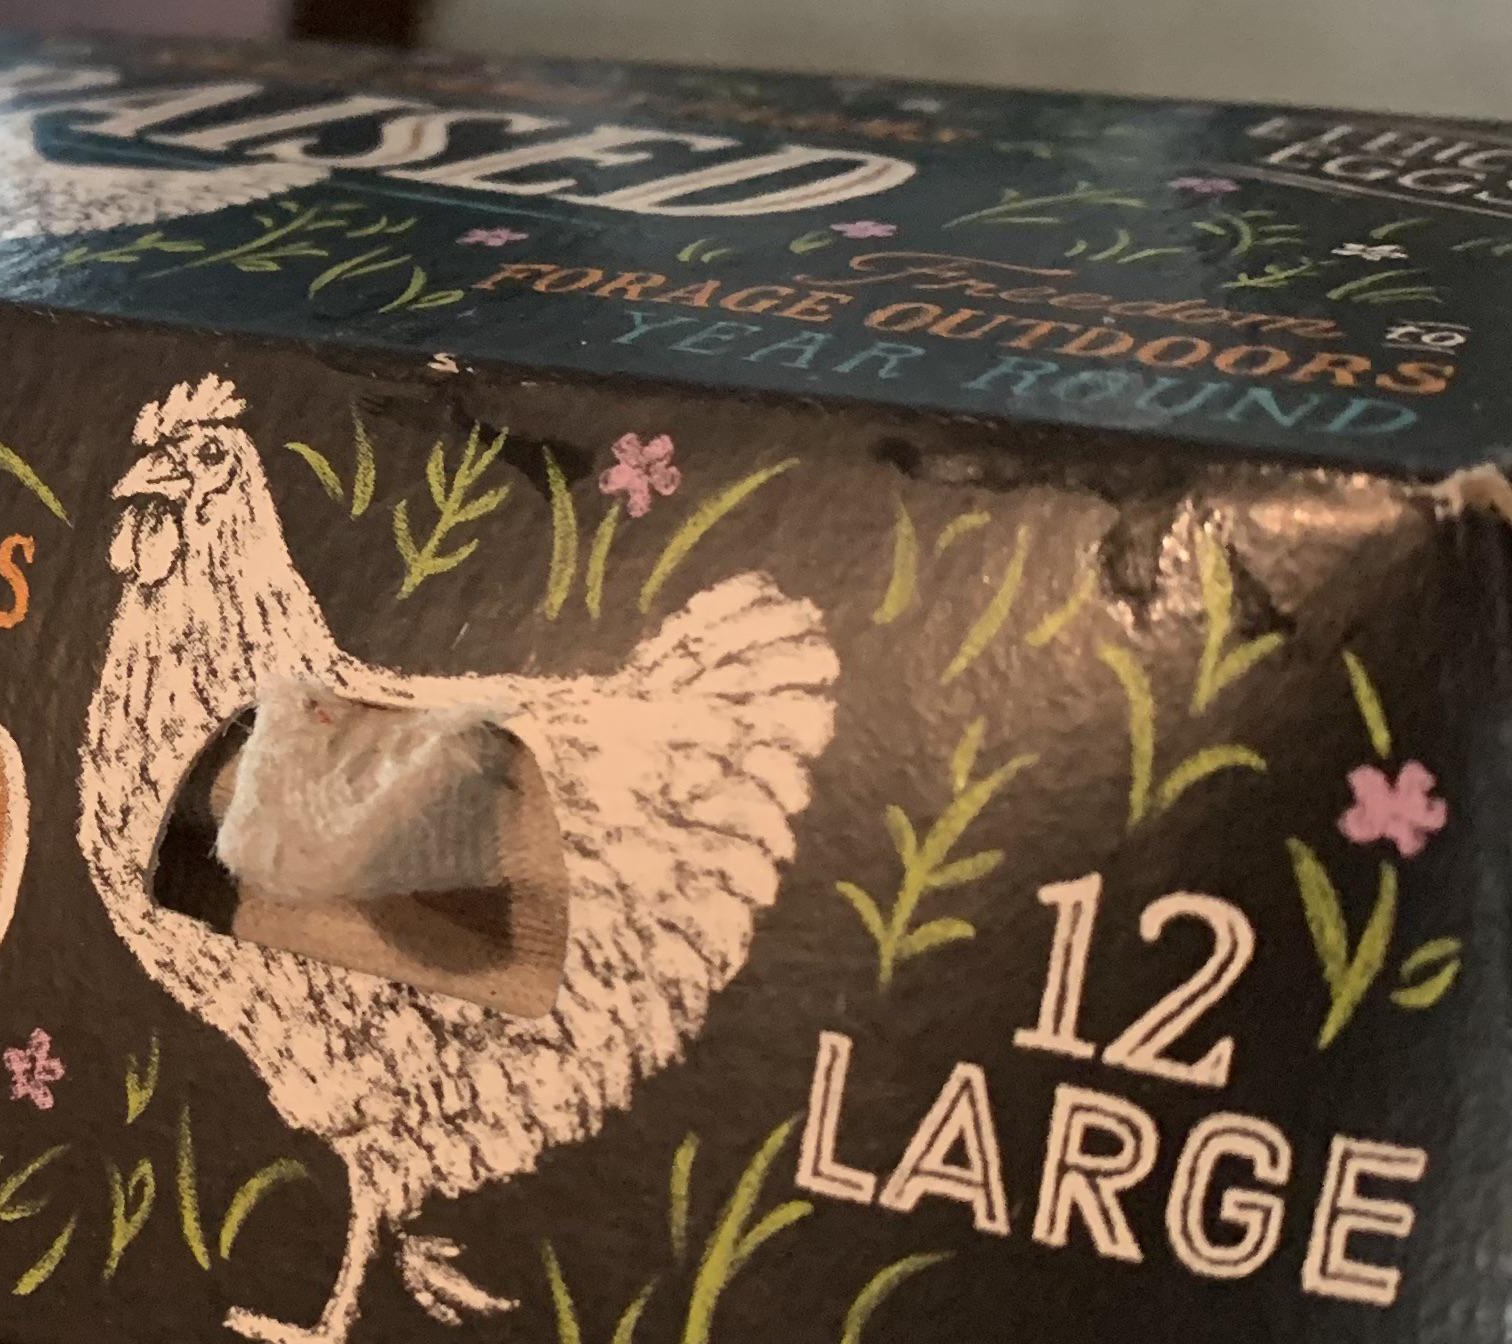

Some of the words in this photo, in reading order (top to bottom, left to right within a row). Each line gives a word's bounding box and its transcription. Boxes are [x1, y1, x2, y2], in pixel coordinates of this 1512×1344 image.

[470, 262, 855, 323] FORAGE
[862, 301, 1456, 395] OUTDOORS
[611, 310, 927, 380] YEAR
[959, 355, 1419, 435] ROUND
[1013, 871, 1256, 1087] 12
[794, 1030, 1428, 1307] LARGE
